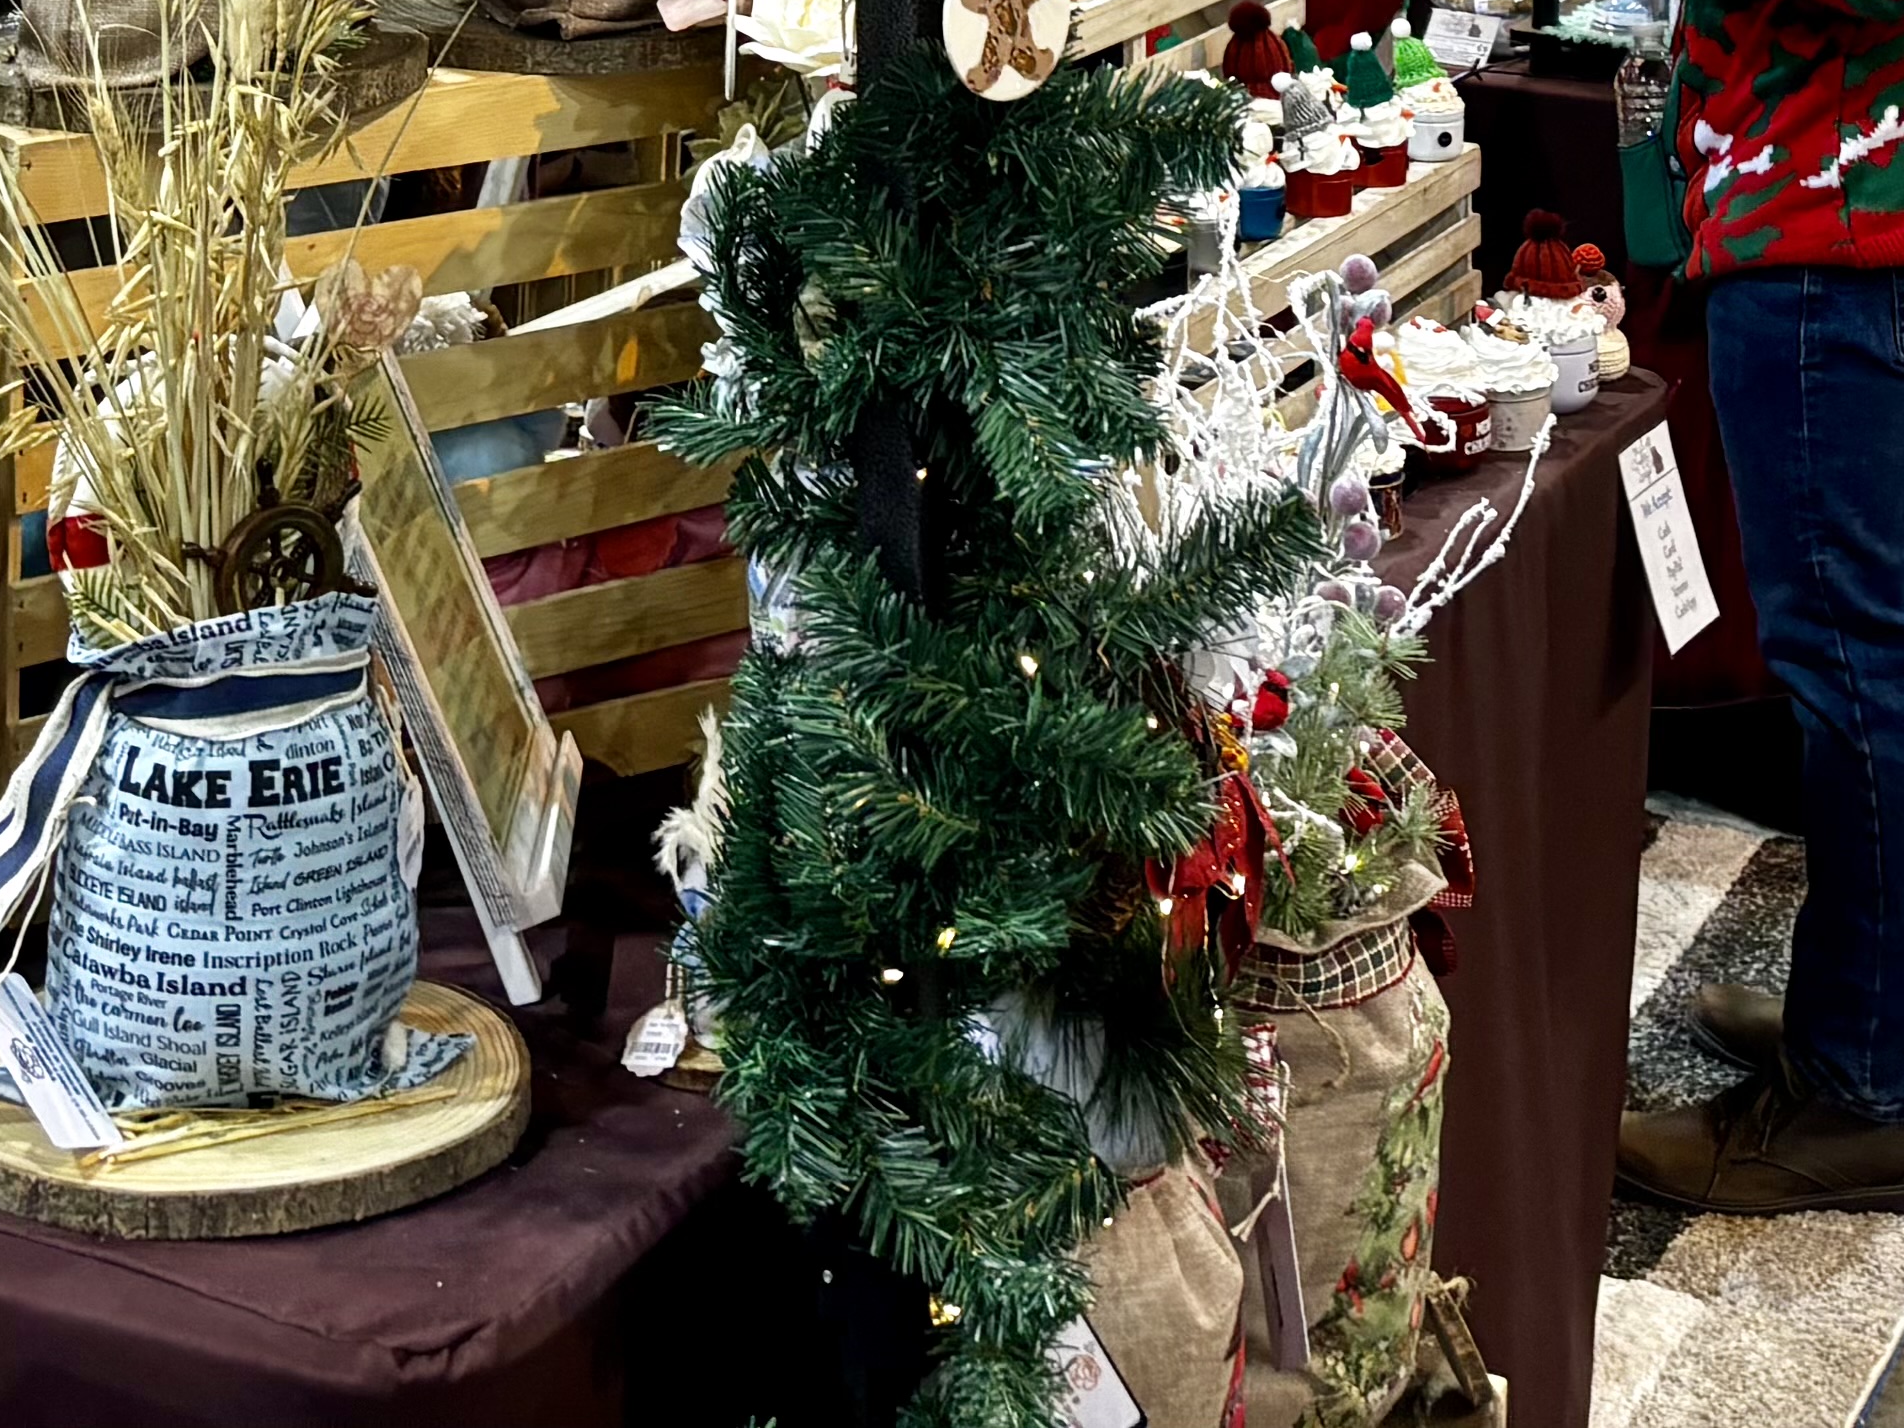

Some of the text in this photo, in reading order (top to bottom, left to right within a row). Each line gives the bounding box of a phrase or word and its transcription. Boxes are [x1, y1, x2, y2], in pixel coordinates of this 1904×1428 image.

[118, 744, 346, 809] LAKE ERIE
[119, 802, 219, 843] Put-in-Bay
[156, 841, 221, 864] ISLAND
[225, 814, 244, 922] Marblehead
[117, 885, 168, 913] ISLAND
[251, 902, 283, 918] Port
[285, 893, 334, 914] Clinton
[86, 924, 142, 963] Shirley
[146, 944, 196, 968] Irene
[166, 921, 274, 943] CEDAR POINT
[279, 916, 328, 941] Crystal
[62, 936, 249, 999] Catawba Island
[202, 935, 359, 973] Inscription Rock
[102, 1020, 152, 1049] Island
[156, 1034, 208, 1056] Shoal
[139, 1052, 198, 1074] Glacial
